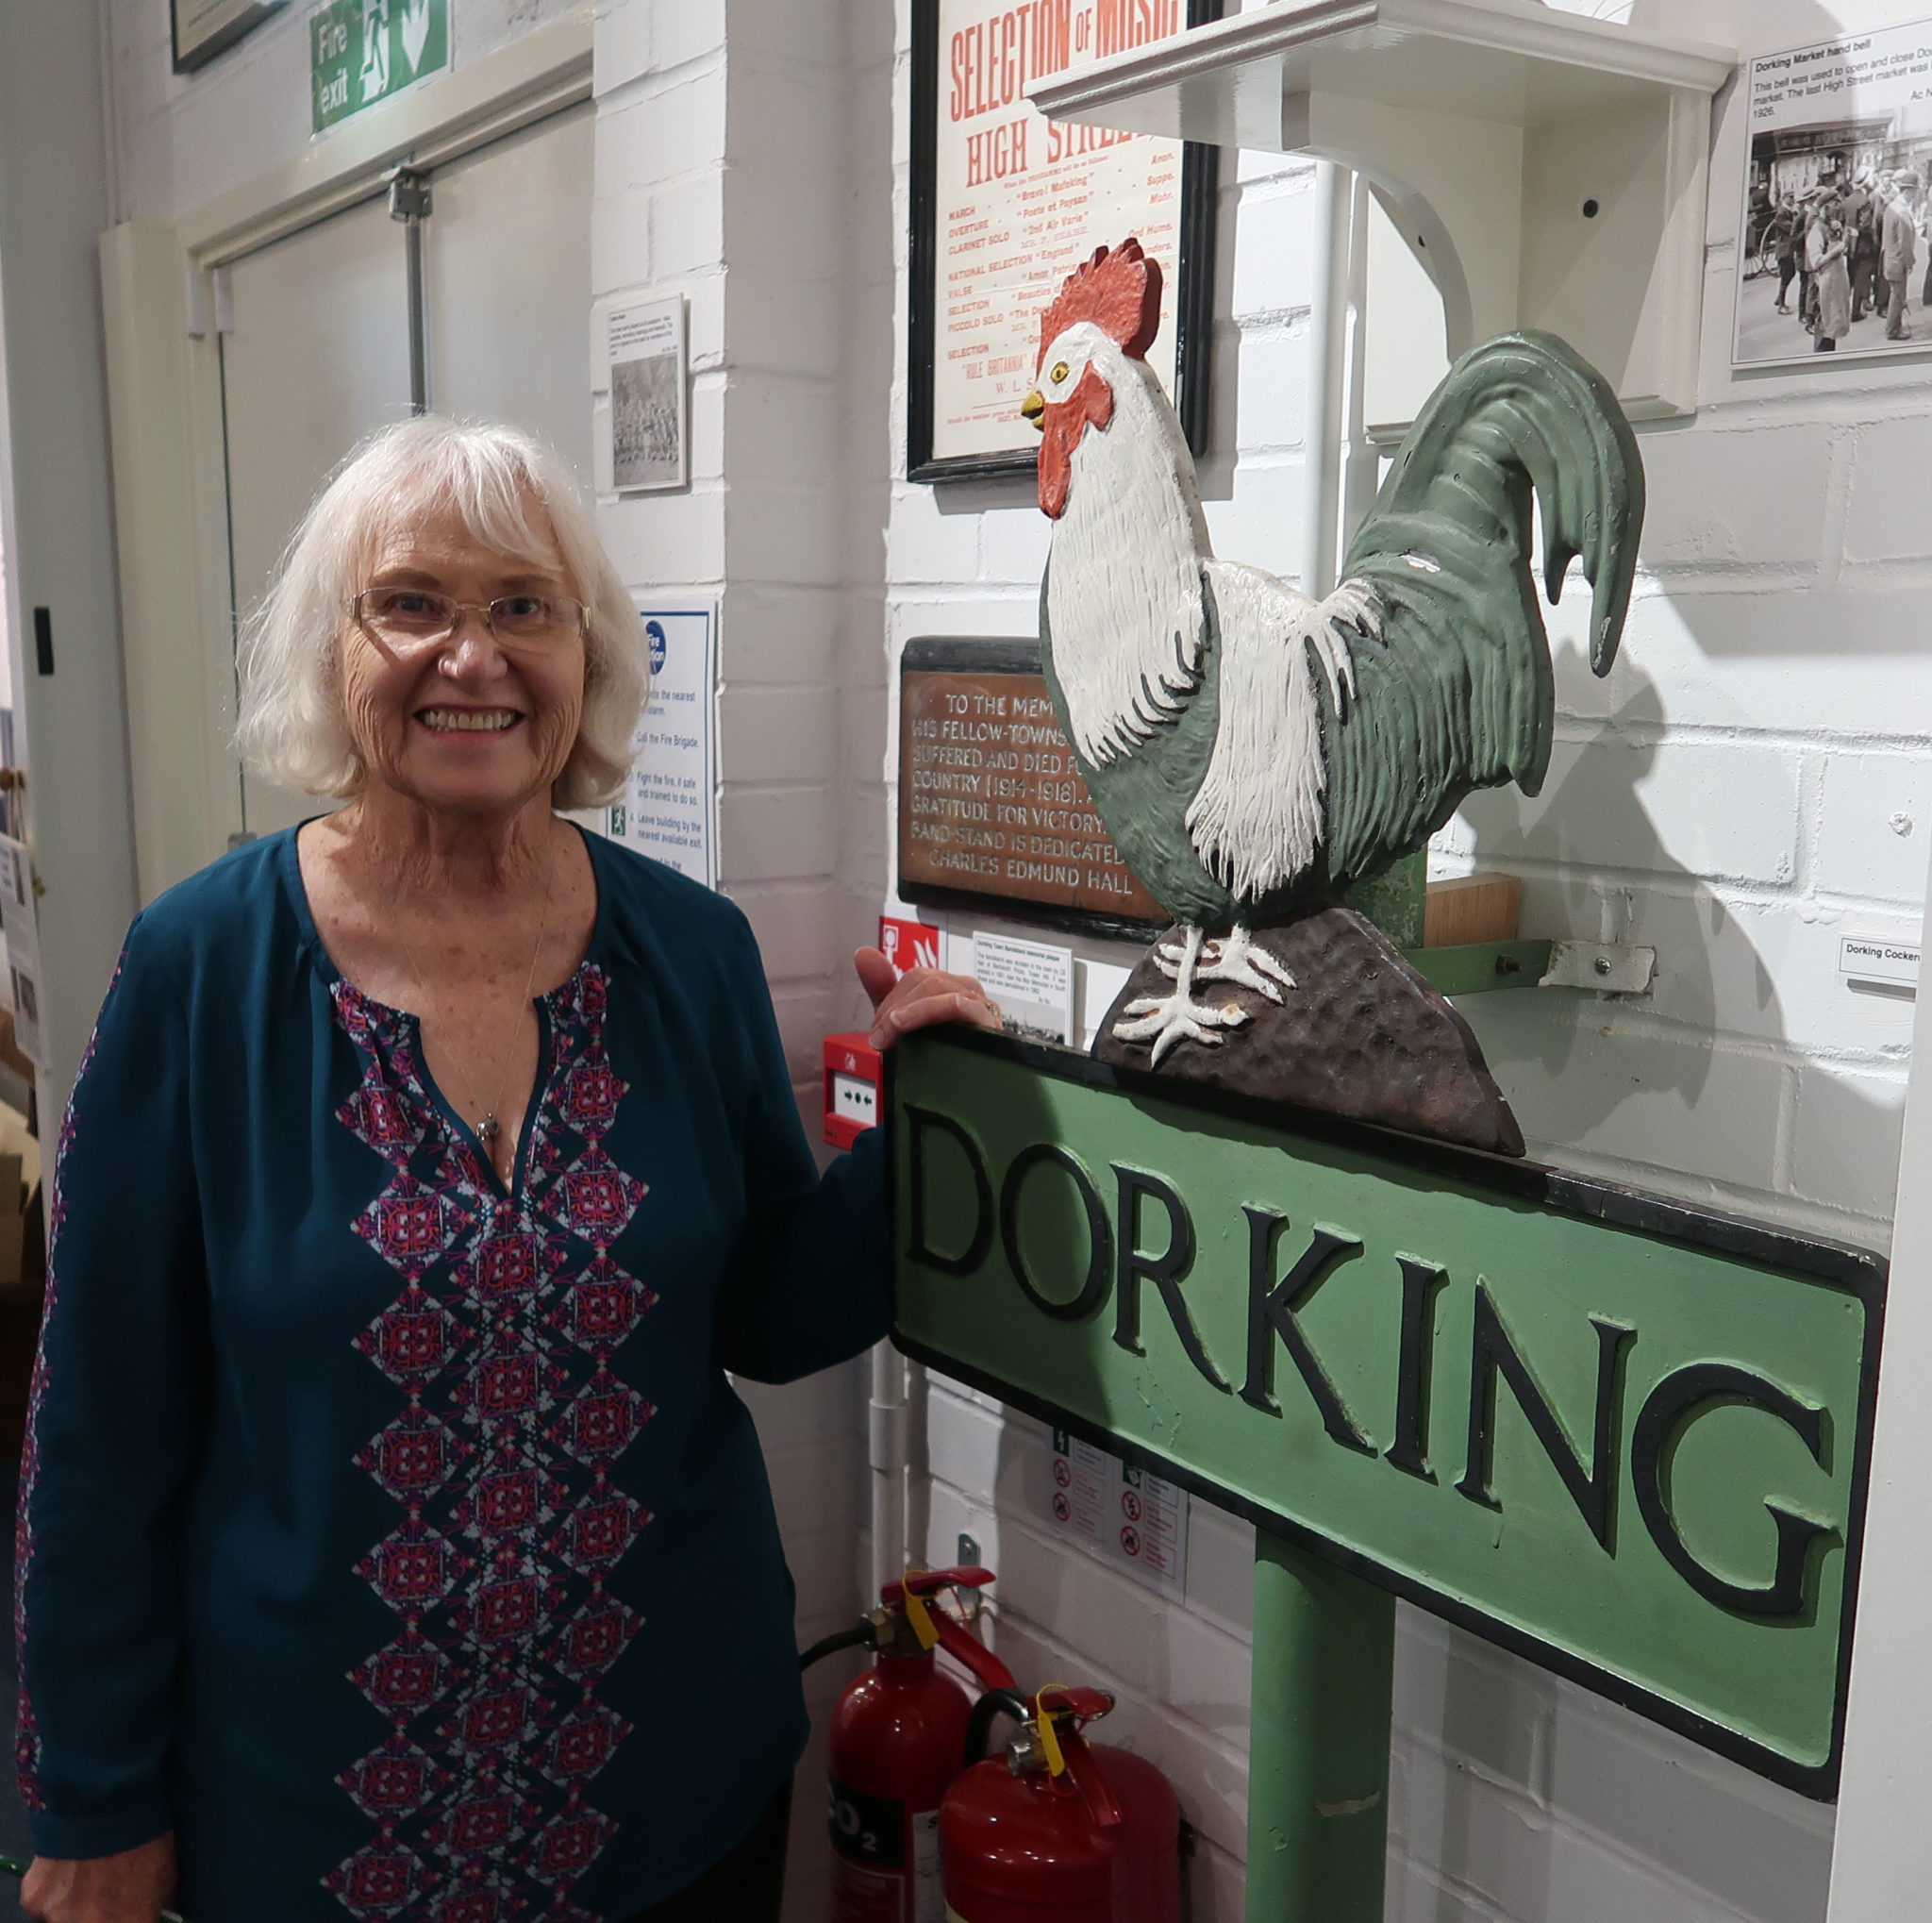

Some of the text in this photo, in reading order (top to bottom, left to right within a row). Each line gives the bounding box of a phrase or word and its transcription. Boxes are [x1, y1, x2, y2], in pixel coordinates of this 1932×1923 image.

[319, 23, 347, 64] Fire
[1076, 8, 1092, 52] OF
[1756, 39, 1873, 73] Dorking Market hand bell
[1755, 80, 1773, 92] This
[1774, 76, 1790, 89] bell
[1791, 75, 1809, 85] was
[1810, 69, 1833, 81] used
[1834, 67, 1844, 76] to
[1845, 62, 1869, 75] open
[1871, 58, 1889, 69] and
[1890, 51, 1916, 65] close
[1787, 89, 1805, 99] The
[1805, 84, 1822, 95] last
[1824, 79, 1844, 92] High
[1845, 74, 1874, 87] Street
[1875, 66, 1908, 81] market
[1909, 62, 1929, 74] was
[321, 67, 348, 114] exit
[966, 117, 1028, 189] HIGH
[949, 237, 987, 256] CLARINET
[989, 231, 1010, 245] SOLO
[948, 264, 987, 282] NATIONAL
[989, 253, 1034, 273] SELECTION
[948, 298, 991, 317] SELECTION
[948, 318, 981, 332] PICCOLO
[982, 312, 1005, 326] SOLO
[947, 343, 990, 360] SELECTION
[946, 694, 1054, 717] TO THE MEM
[637, 730, 700, 749] Call the Fire Brigade.
[912, 718, 1070, 746] HIS FELLOW-TOWNS
[912, 744, 1062, 774] SUFFERED AND DIED
[638, 788, 649, 798] and
[653, 774, 662, 785] the
[683, 778, 696, 790] safe
[912, 769, 981, 793] COUNTRY
[638, 812, 701, 833] Leave building by the
[912, 794, 1107, 835] GRATITUDE FOR VICTORY.
[1011, 833, 1027, 853] IS
[928, 847, 1133, 895] CHARLES EDMUND HALL
[1846, 944, 1883, 959] Dorking
[904, 1101, 1842, 1627] DORKING
